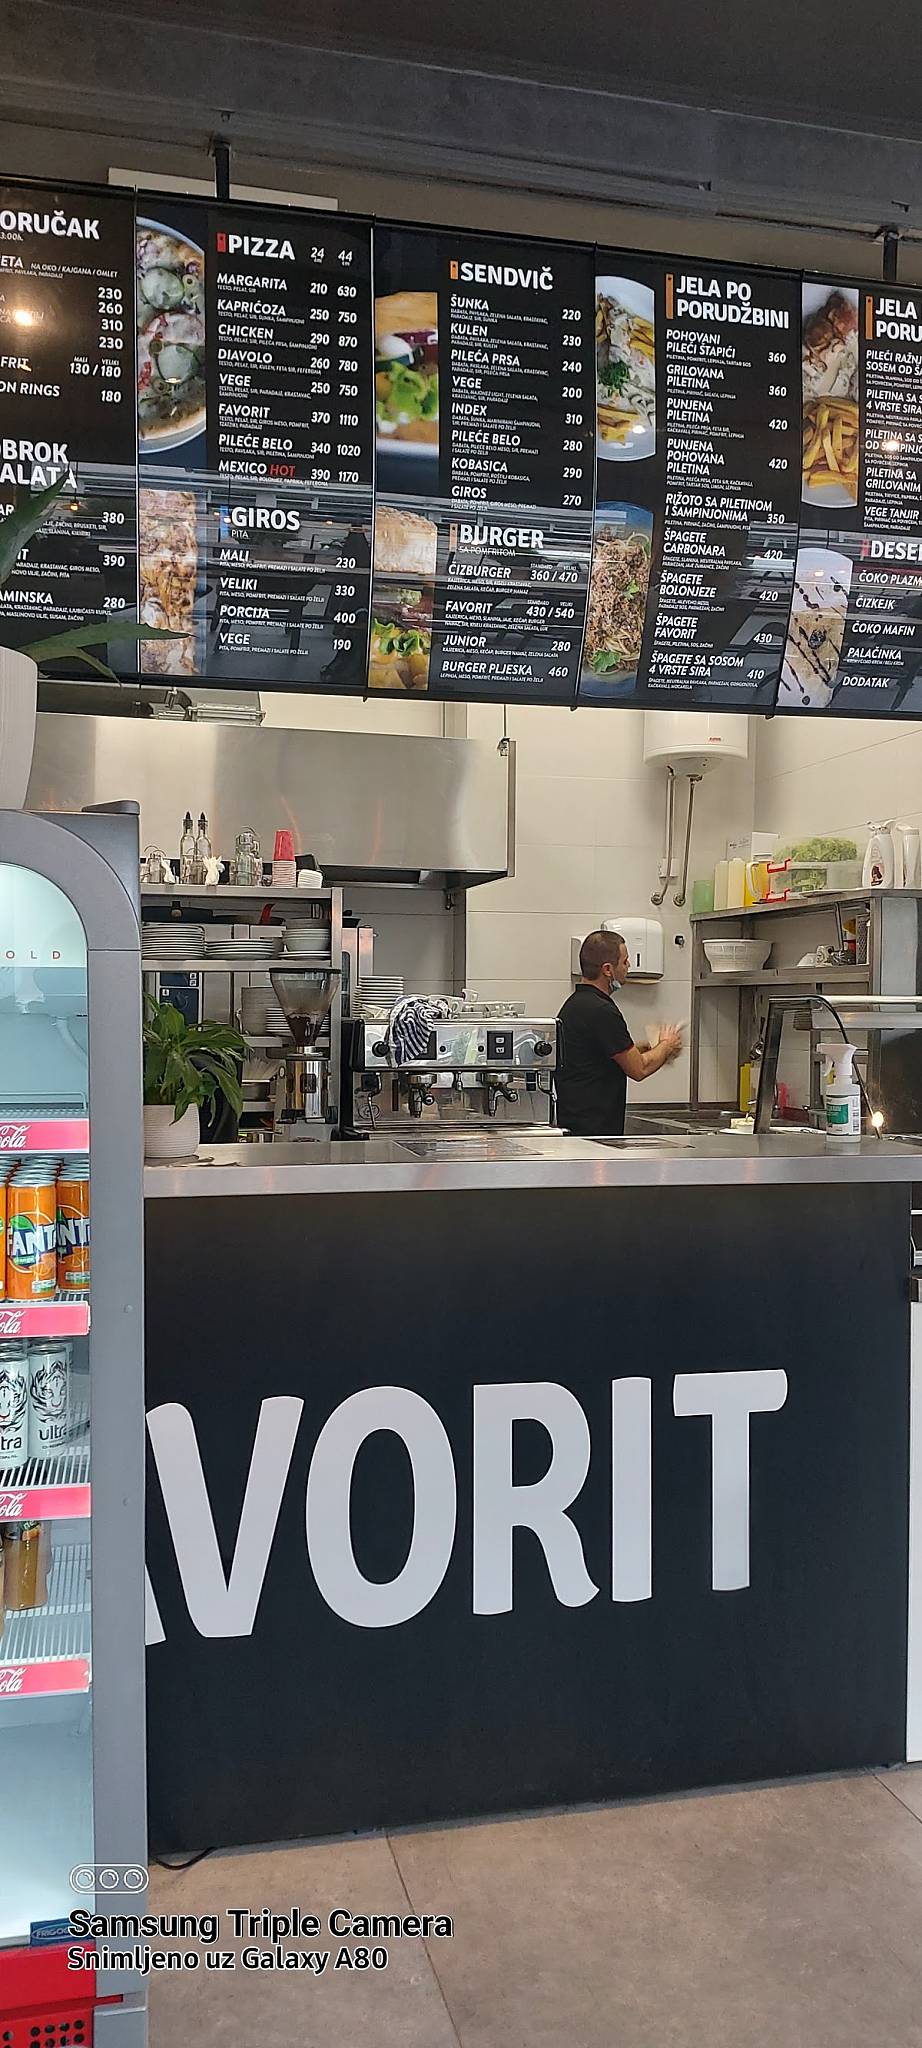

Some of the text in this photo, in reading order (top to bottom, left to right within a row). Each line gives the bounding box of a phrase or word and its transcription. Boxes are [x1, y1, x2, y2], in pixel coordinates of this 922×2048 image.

[228, 234, 353, 263] PIZZA 24 44
[96, 269, 118, 279] OMLET
[460, 262, 554, 291] SENDVIČ
[98, 286, 122, 300] 230
[217, 272, 288, 291] MARGARITA
[310, 282, 328, 295] 210
[337, 285, 357, 298] 630
[676, 275, 752, 302] JELA PO
[98, 302, 123, 315] 260
[450, 293, 490, 311] ŠUNKA
[561, 308, 582, 321] 220
[676, 298, 790, 330] PORUDŽBINI
[875, 297, 918, 320] JELA
[310, 308, 330, 321] 250
[338, 311, 357, 324] 750
[101, 318, 123, 332] 310
[99, 336, 123, 350] 230
[218, 323, 274, 340] CHICKEN
[310, 332, 330, 346] 290
[338, 335, 358, 348] 870
[450, 322, 488, 337] KULEN
[561, 335, 582, 348] 230
[666, 328, 721, 345] POHOVANI
[666, 341, 736, 359] PILEĆI ŠTAPIĆI
[767, 351, 787, 364] 360
[217, 348, 273, 364] DIAVOLO
[310, 357, 331, 370] 260
[338, 359, 359, 372] 780
[450, 348, 490, 364] PILEĆA
[492, 353, 521, 367] PRSA
[561, 360, 582, 373] 240
[70, 362, 122, 378] 130 180
[666, 364, 725, 380] GRILOVANA
[898, 364, 913, 376] OD
[20, 382, 122, 403] RINGS 180
[219, 373, 359, 397] VEGE 250 750
[452, 375, 583, 399] VEGE 200
[666, 375, 788, 397] PILETINA 360
[866, 389, 904, 403] PILETINA
[451, 402, 583, 425] INDEX 310
[666, 397, 714, 413] PUNJENA
[874, 401, 902, 413] VRSTE
[218, 403, 271, 419] FAVORIT
[310, 411, 331, 424] 370
[339, 413, 359, 427] 1110
[666, 409, 711, 424] PILETINA
[768, 418, 788, 431] 420
[451, 429, 583, 452] PILEĆE BELO 280
[865, 428, 903, 442] PILETINA
[218, 433, 260, 449] PILEĆE
[262, 437, 293, 451] BELO
[310, 441, 331, 455] 340
[336, 444, 361, 457] 1020
[666, 438, 714, 453] PUNJENA
[666, 449, 725, 465] POHOVANA
[768, 458, 788, 470] 420
[218, 459, 267, 474] MEXICO
[270, 463, 296, 477] HOT
[310, 468, 331, 481] 390
[338, 470, 359, 483] 1170
[451, 457, 583, 479] KOBASICA 290
[666, 461, 711, 476] PILETINA
[865, 467, 904, 480] PILETINA
[865, 479, 921, 493] GRILOVANIM
[451, 485, 582, 507] GIROS 270
[665, 491, 773, 512] RIŽOTO SA PILETINOM
[101, 511, 125, 525] 380
[231, 506, 301, 531] GIROS
[671, 503, 748, 522] ŠAMPINJONIMA
[766, 513, 785, 525] 350
[864, 506, 920, 520] VEGE TANJIR
[231, 529, 249, 539] PITA
[460, 523, 544, 549] BURGER
[663, 527, 707, 543] ŠPAGETE
[663, 542, 726, 557] CARBONARA
[763, 549, 783, 561] 420
[103, 555, 126, 568] 390
[219, 548, 250, 562] MALI
[335, 557, 357, 569] 230
[448, 560, 578, 583] ČIZBURGER 360 470
[660, 570, 704, 585] ŠPAGETE
[859, 569, 889, 583] ČOKO
[219, 576, 258, 591] VELIKI
[334, 584, 356, 597] 330
[659, 584, 779, 602] BOLONJEZE 420
[103, 597, 126, 609] 280
[445, 600, 575, 619] FAVORIT 430 540
[219, 604, 357, 624] PORCIJA 400
[655, 613, 699, 628] ŠPAGETE
[654, 627, 773, 644] FAVORIT 430
[851, 621, 916, 636] ČOKO MAFIN
[219, 632, 352, 651] VEGE 190
[443, 634, 571, 652] JUNIOR 280
[650, 650, 745, 668] ŠPAGETE SA SOSOM
[847, 646, 902, 660] PALAČINKA
[442, 660, 487, 673] BURGER
[488, 663, 533, 676] PLJESKA
[548, 666, 568, 678] 460
[658, 664, 712, 678] VRSTE SIRA
[746, 669, 765, 680] 410
[842, 676, 890, 688] DODATAK
[145, 1369, 788, 1646] VORIT
